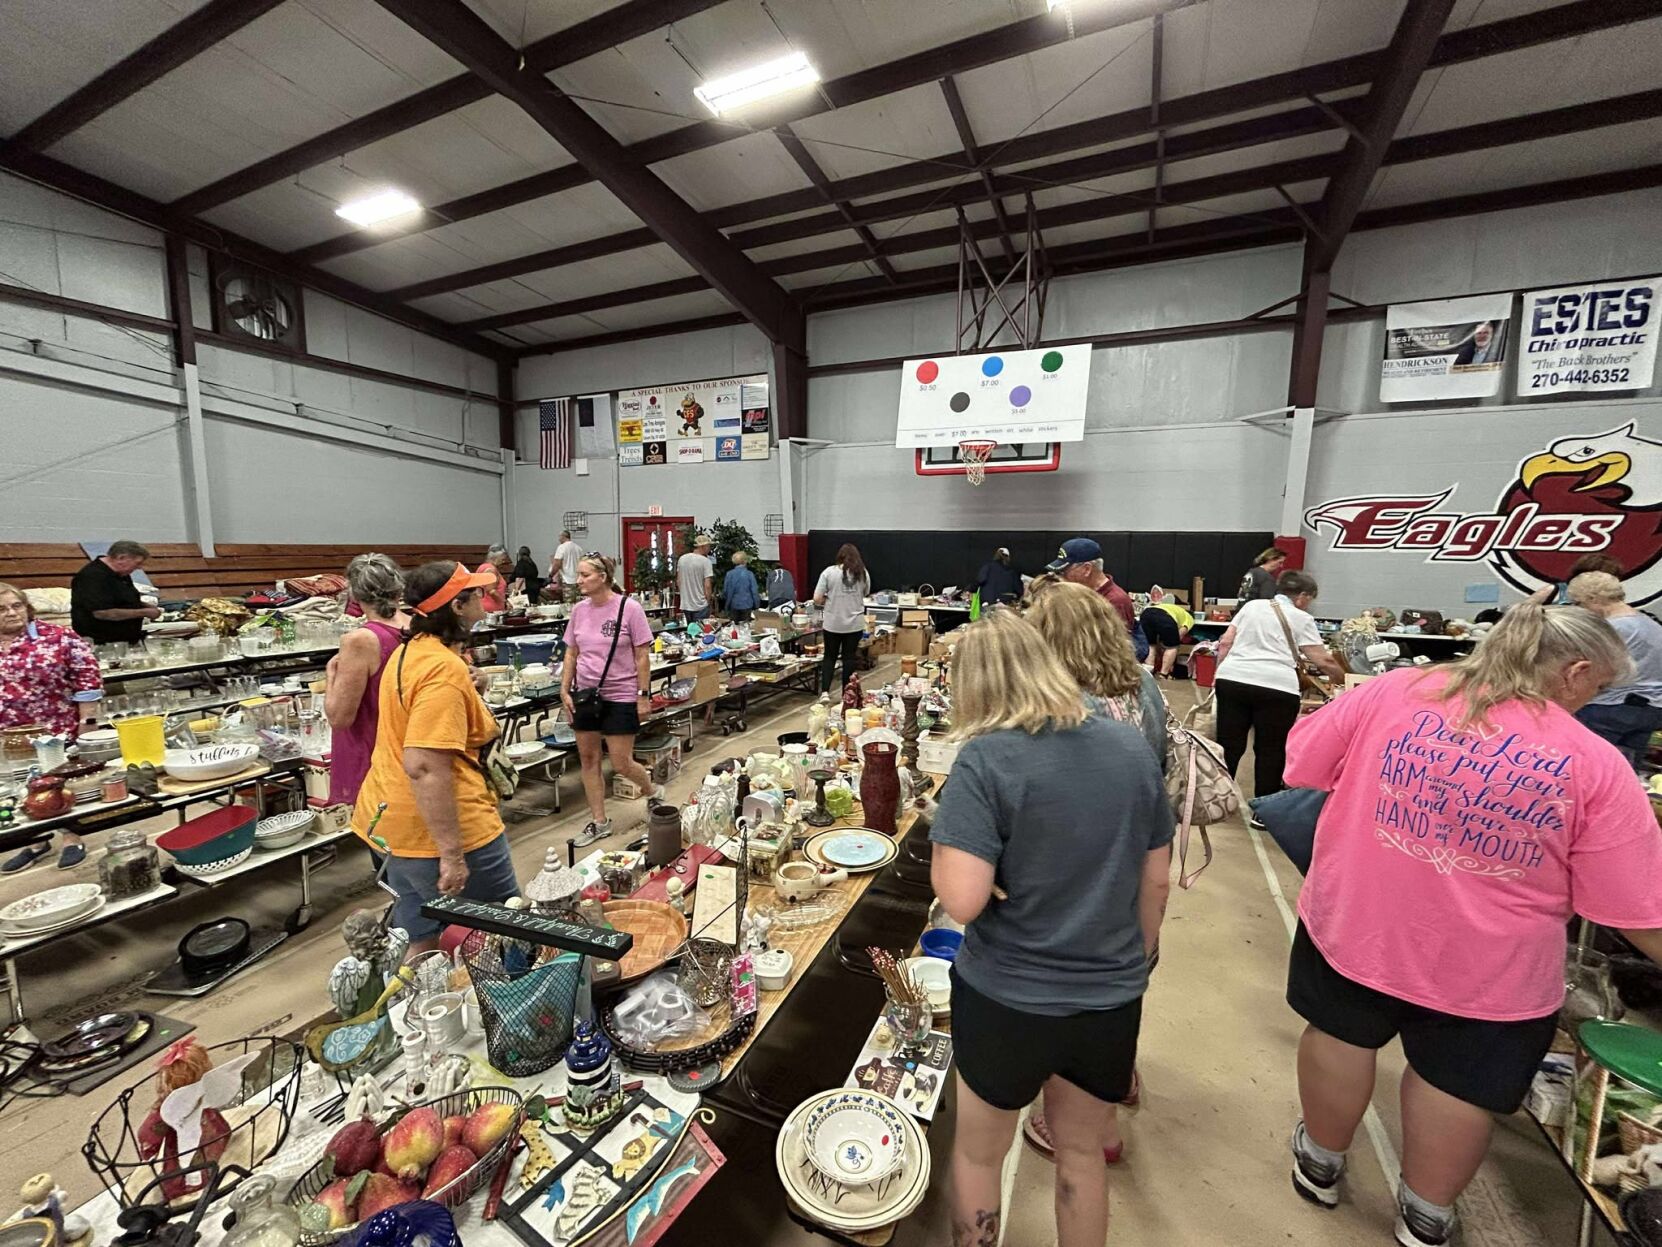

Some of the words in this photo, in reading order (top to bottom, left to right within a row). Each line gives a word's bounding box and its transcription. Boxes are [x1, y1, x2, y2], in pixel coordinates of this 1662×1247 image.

[1532, 286, 1653, 336] ESTES
[1384, 357, 1448, 369] HENDRICKSON
[1532, 368, 1630, 388] 270-442-6352
[1306, 484, 1624, 563] Eagles
[1412, 710, 1481, 754] Dear
[1378, 732, 1448, 762] please
[1444, 755, 1502, 783] put
[1492, 770, 1565, 798] your
[1380, 754, 1427, 793] ARM
[1428, 785, 1447, 800] my
[1412, 794, 1448, 815] and
[1457, 810, 1510, 832] your
[1375, 797, 1429, 838] HAND
[1459, 828, 1544, 868] MOUTH
[531, 917, 593, 939] Thankful
[931, 1039, 947, 1066] COFFEE
